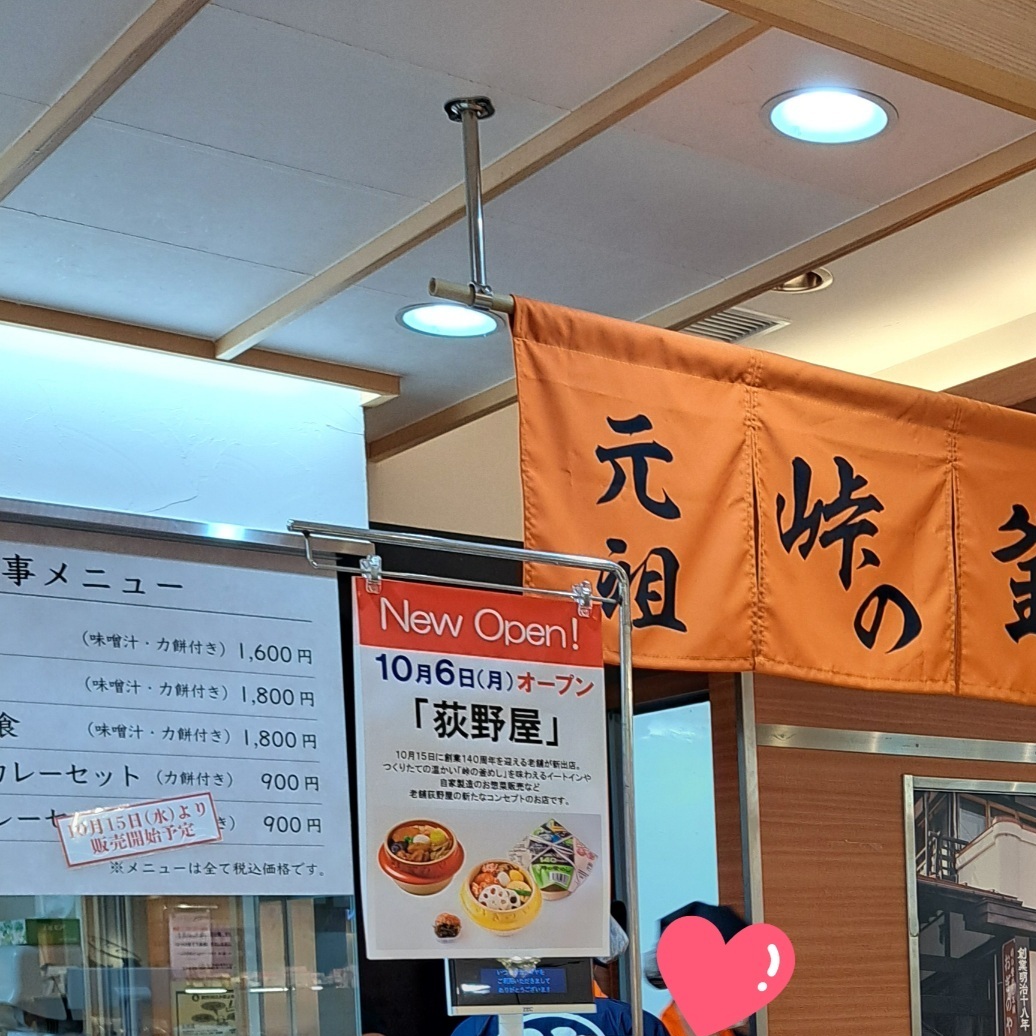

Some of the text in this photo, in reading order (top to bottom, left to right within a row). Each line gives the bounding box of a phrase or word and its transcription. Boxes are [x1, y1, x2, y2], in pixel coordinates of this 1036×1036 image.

[595, 413, 688, 633] 元祖
[380, 597, 579, 651] New Open!
[238, 642, 313, 665] 1,600円
[242, 686, 315, 708] 1,800円
[414, 697, 560, 748] 「荻野屋」
[243, 729, 318, 750] 1,800円
[260, 773, 320, 792] 900円
[263, 815, 322, 834] 900円
[91, 822, 196, 854] 販売開始予定
